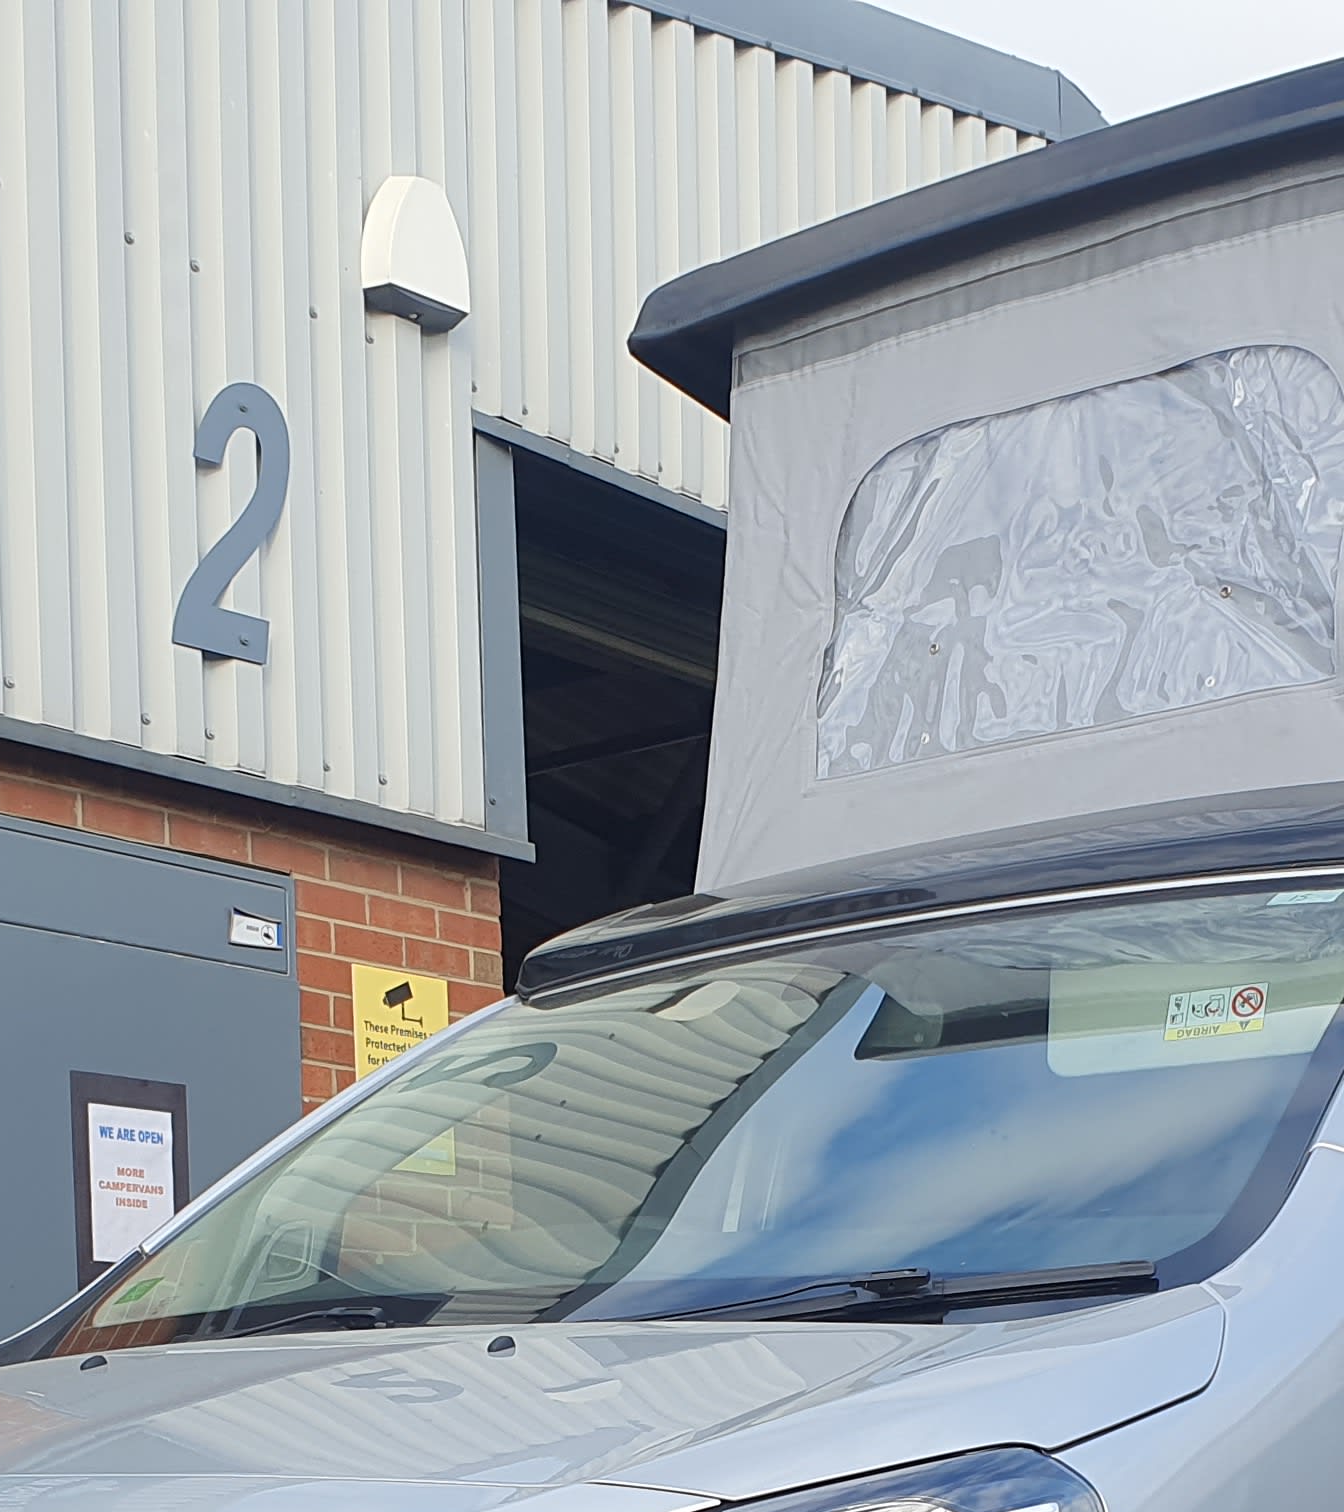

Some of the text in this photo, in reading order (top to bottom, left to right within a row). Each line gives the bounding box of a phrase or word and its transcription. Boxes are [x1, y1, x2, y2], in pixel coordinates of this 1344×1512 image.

[172, 382, 290, 665] 2
[364, 1020, 427, 1040] These Premises
[1177, 1025, 1220, 1038] AIRBAG
[365, 1037, 406, 1052] Protected
[99, 1125, 164, 1144] WE ARE OPEN
[117, 1166, 144, 1178] MORE
[99, 1180, 164, 1195] CAMPERVANS
[116, 1197, 148, 1208] INSIDE
